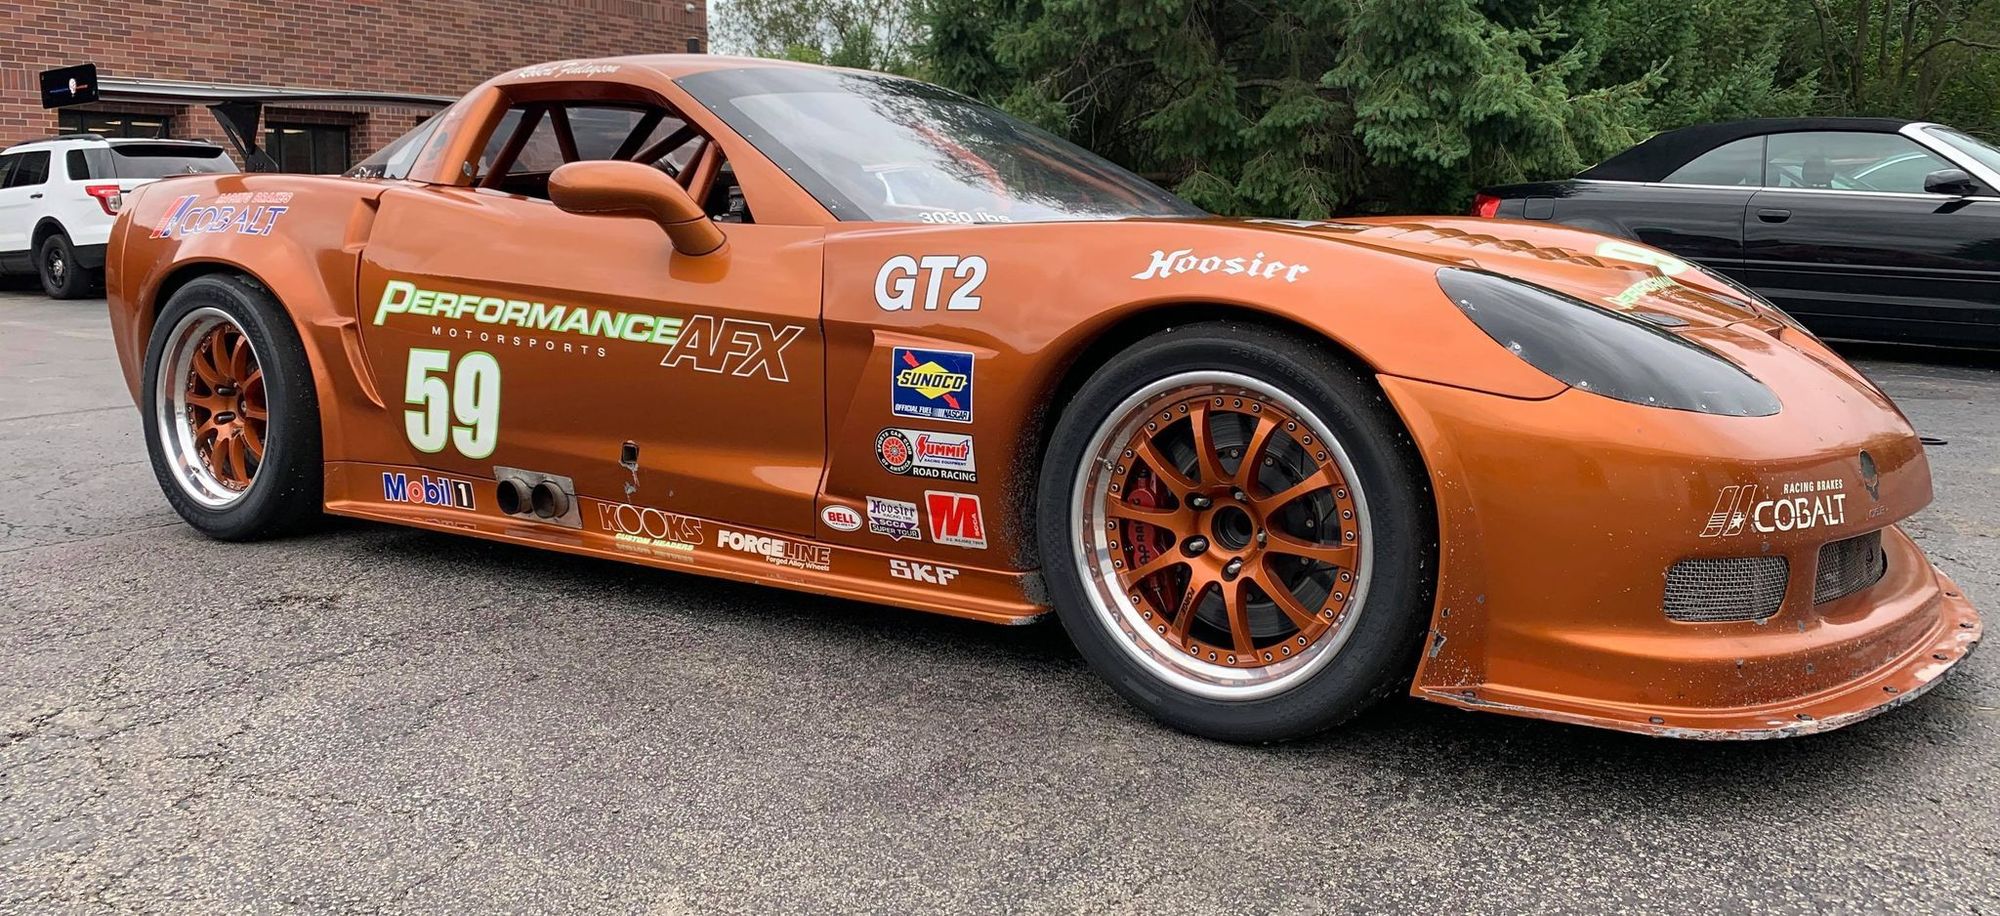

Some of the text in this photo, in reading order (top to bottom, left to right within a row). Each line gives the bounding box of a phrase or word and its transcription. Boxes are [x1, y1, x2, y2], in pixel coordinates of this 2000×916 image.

[181, 205, 289, 236] COBALT
[919, 211, 1013, 224] 3030 lbs
[1131, 248, 1309, 283] Hoosier
[874, 254, 988, 312] GT2
[373, 280, 805, 382] PERFORMANCE AFX
[431, 326, 607, 357] MOTORSPORTS
[900, 371, 965, 390] SUNOCO
[404, 347, 500, 460] 59
[895, 403, 932, 414] OFFICIAL FUEL
[943, 409, 969, 420] NASCAR
[890, 430, 902, 438] CAR
[913, 467, 976, 482] ROAD RACING
[383, 472, 453, 507] Mobil
[1783, 479, 1843, 494] RACING BRAKES
[828, 511, 856, 524] BELL
[870, 500, 915, 517] Hoosier
[1754, 494, 1846, 533] COBALT
[597, 502, 704, 545] KOOKS
[872, 524, 918, 538] SUPER TOUR
[880, 519, 907, 529] SCCA
[717, 529, 831, 565] FORGELINE
[765, 555, 830, 571] Forged Alloy Wheels
[889, 559, 959, 586] SKF
